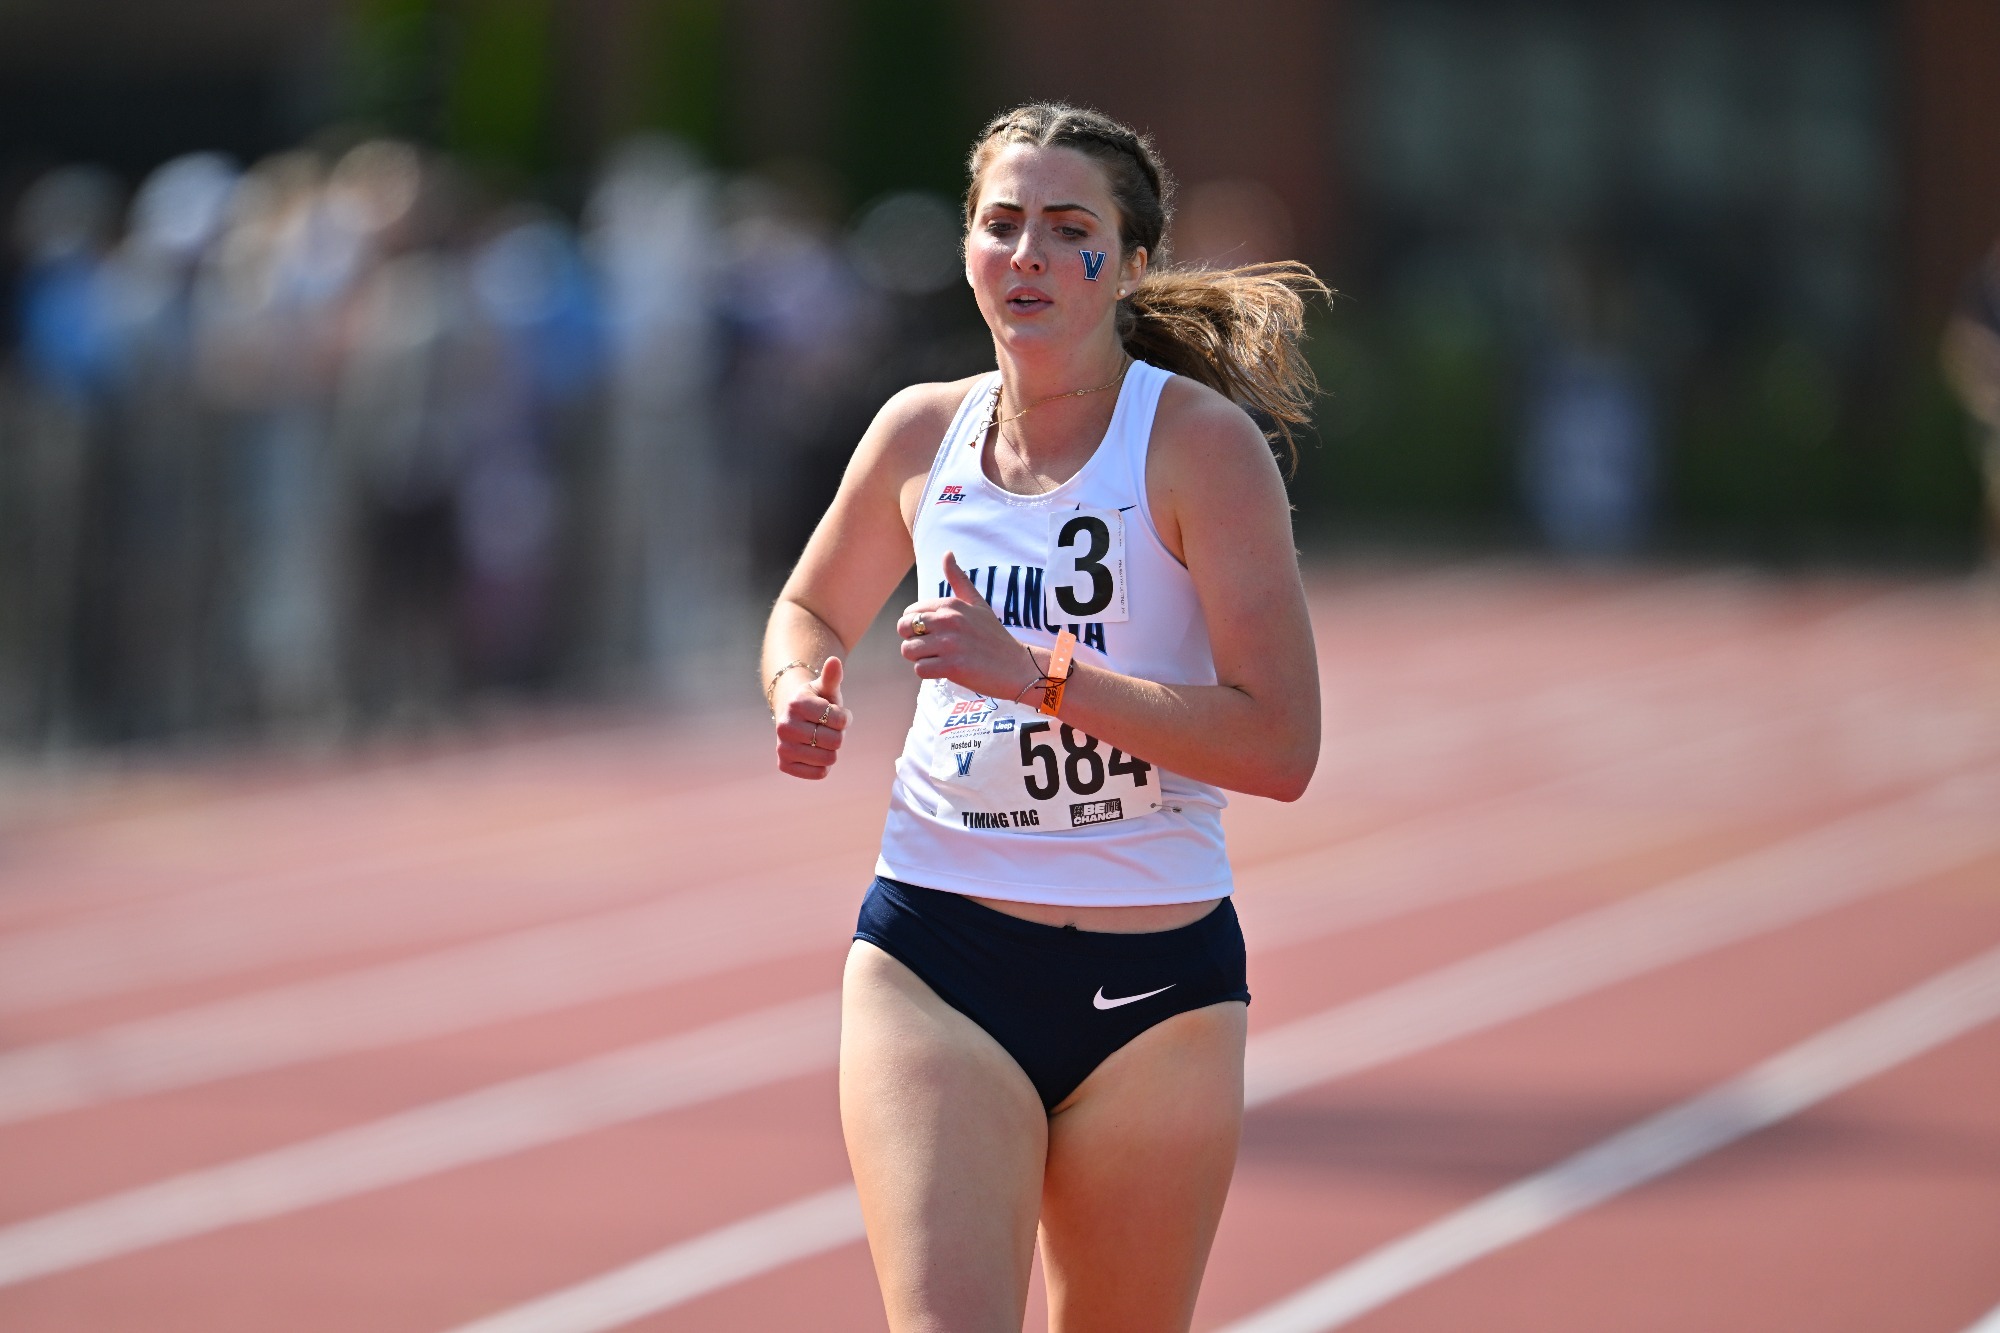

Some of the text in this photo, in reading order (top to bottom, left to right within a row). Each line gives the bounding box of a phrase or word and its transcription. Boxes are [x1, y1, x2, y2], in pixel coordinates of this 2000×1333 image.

[1079, 250, 1106, 281] V
[943, 486, 962, 494] BIG
[1055, 515, 1114, 616] 3
[951, 699, 986, 714] BIG
[944, 710, 992, 727] EAST
[995, 722, 1013, 731] Jeep
[951, 739, 982, 750] Hosted by
[954, 750, 975, 777] V
[1019, 721, 1151, 800] 584
[961, 809, 1040, 829] TIMING TAG
[1073, 811, 1120, 825] CHANGE
